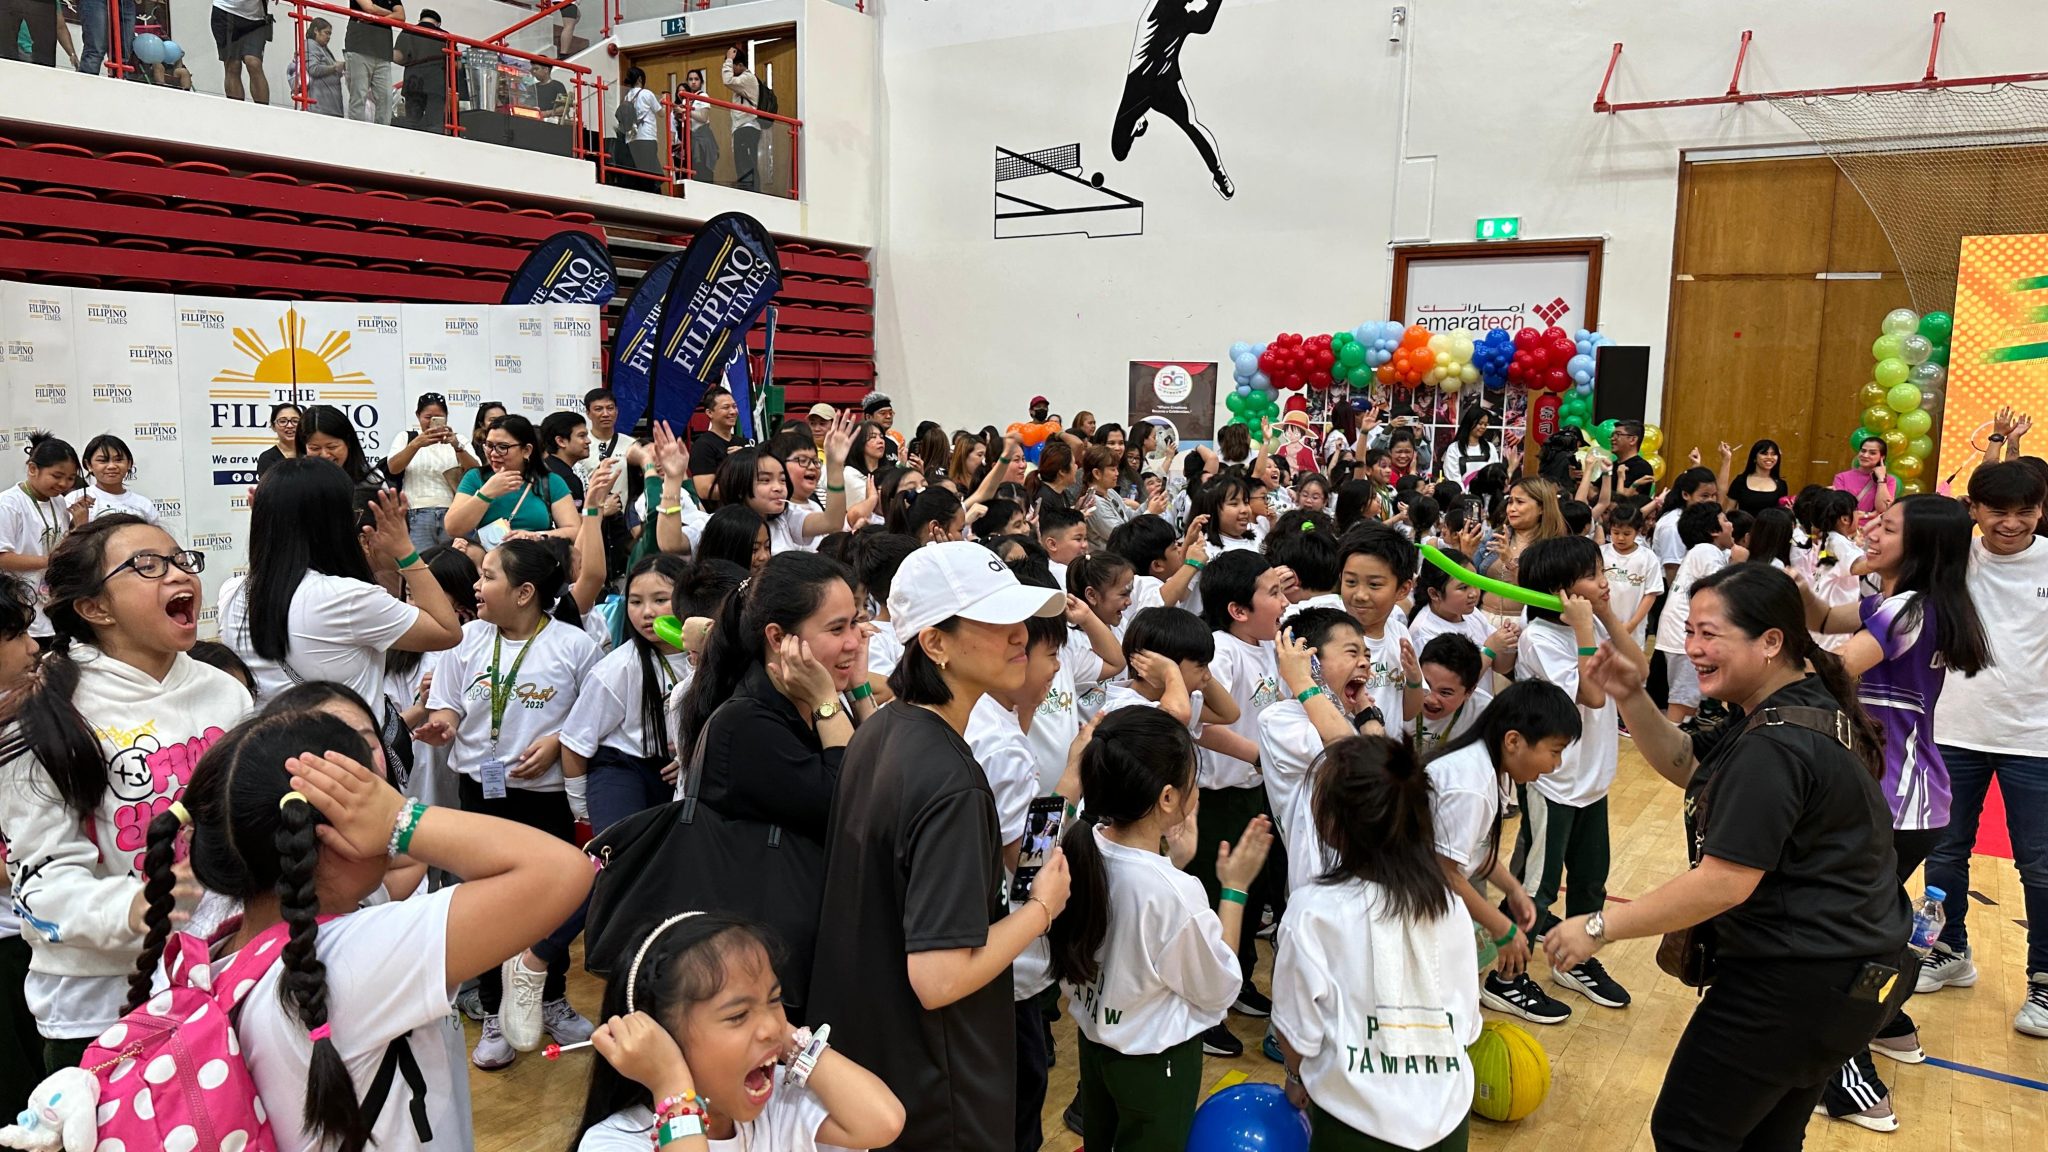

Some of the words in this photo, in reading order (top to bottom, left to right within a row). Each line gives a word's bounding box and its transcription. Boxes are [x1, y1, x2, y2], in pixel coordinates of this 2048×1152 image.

[572, 268, 610, 304] MES
[724, 257, 771, 324] TIMES
[29, 304, 60, 314] FILIPINO
[88, 308, 127, 317] FILIPINO
[673, 245, 753, 374] FILIPINO
[106, 317, 128, 325] TIMES
[181, 313, 224, 323] FILIPINO
[1416, 314, 1524, 331] emaratech
[554, 322, 591, 330] FILIPINO
[129, 350, 173, 358] FILIPINO
[35, 388, 66, 398] FILIPINO
[93, 388, 132, 397] FILIPINO
[275, 389, 316, 401] THE
[134, 427, 177, 435] FILIPINO
[212, 455, 227, 464] We
[193, 537, 232, 547] FILIPINO
[516, 683, 557, 703] Fest
[525, 701, 544, 709] 2025
[1347, 1045, 1467, 1074] TAMARA
